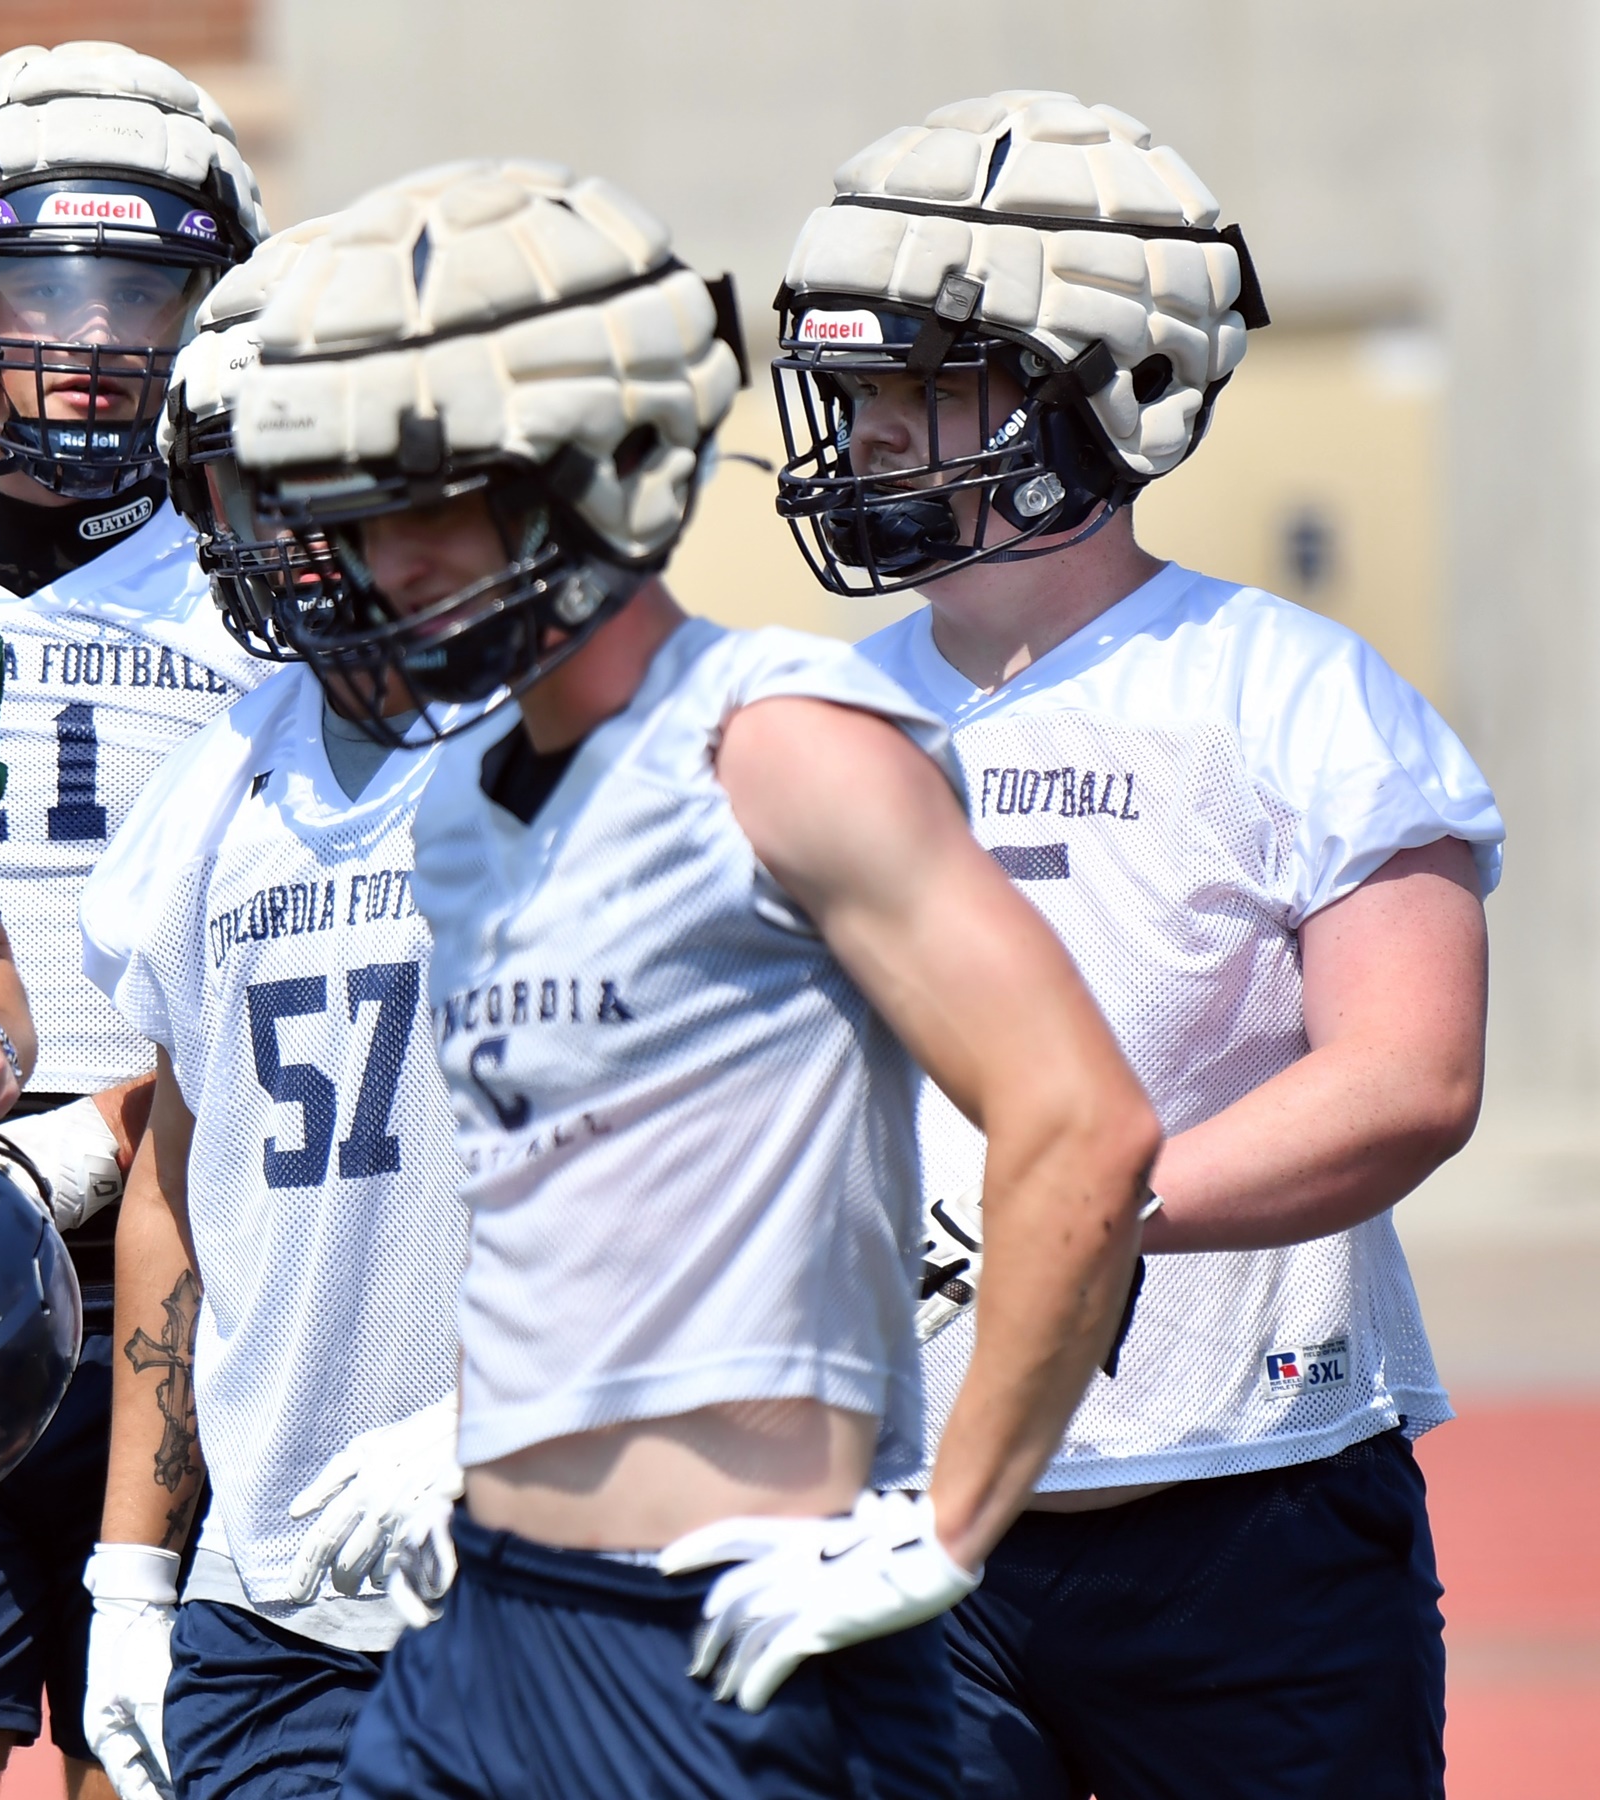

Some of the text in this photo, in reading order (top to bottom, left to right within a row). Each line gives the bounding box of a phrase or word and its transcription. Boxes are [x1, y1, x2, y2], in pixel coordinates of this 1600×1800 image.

[54, 199, 142, 220] Riddell
[803, 317, 864, 339] Riddell
[87, 502, 150, 536] BATTLE
[38, 642, 228, 695] FOOTBALL
[981, 766, 1140, 820] FOOTBALL
[246, 961, 420, 1189] 57
[1308, 1359, 1344, 1385] 3XL
